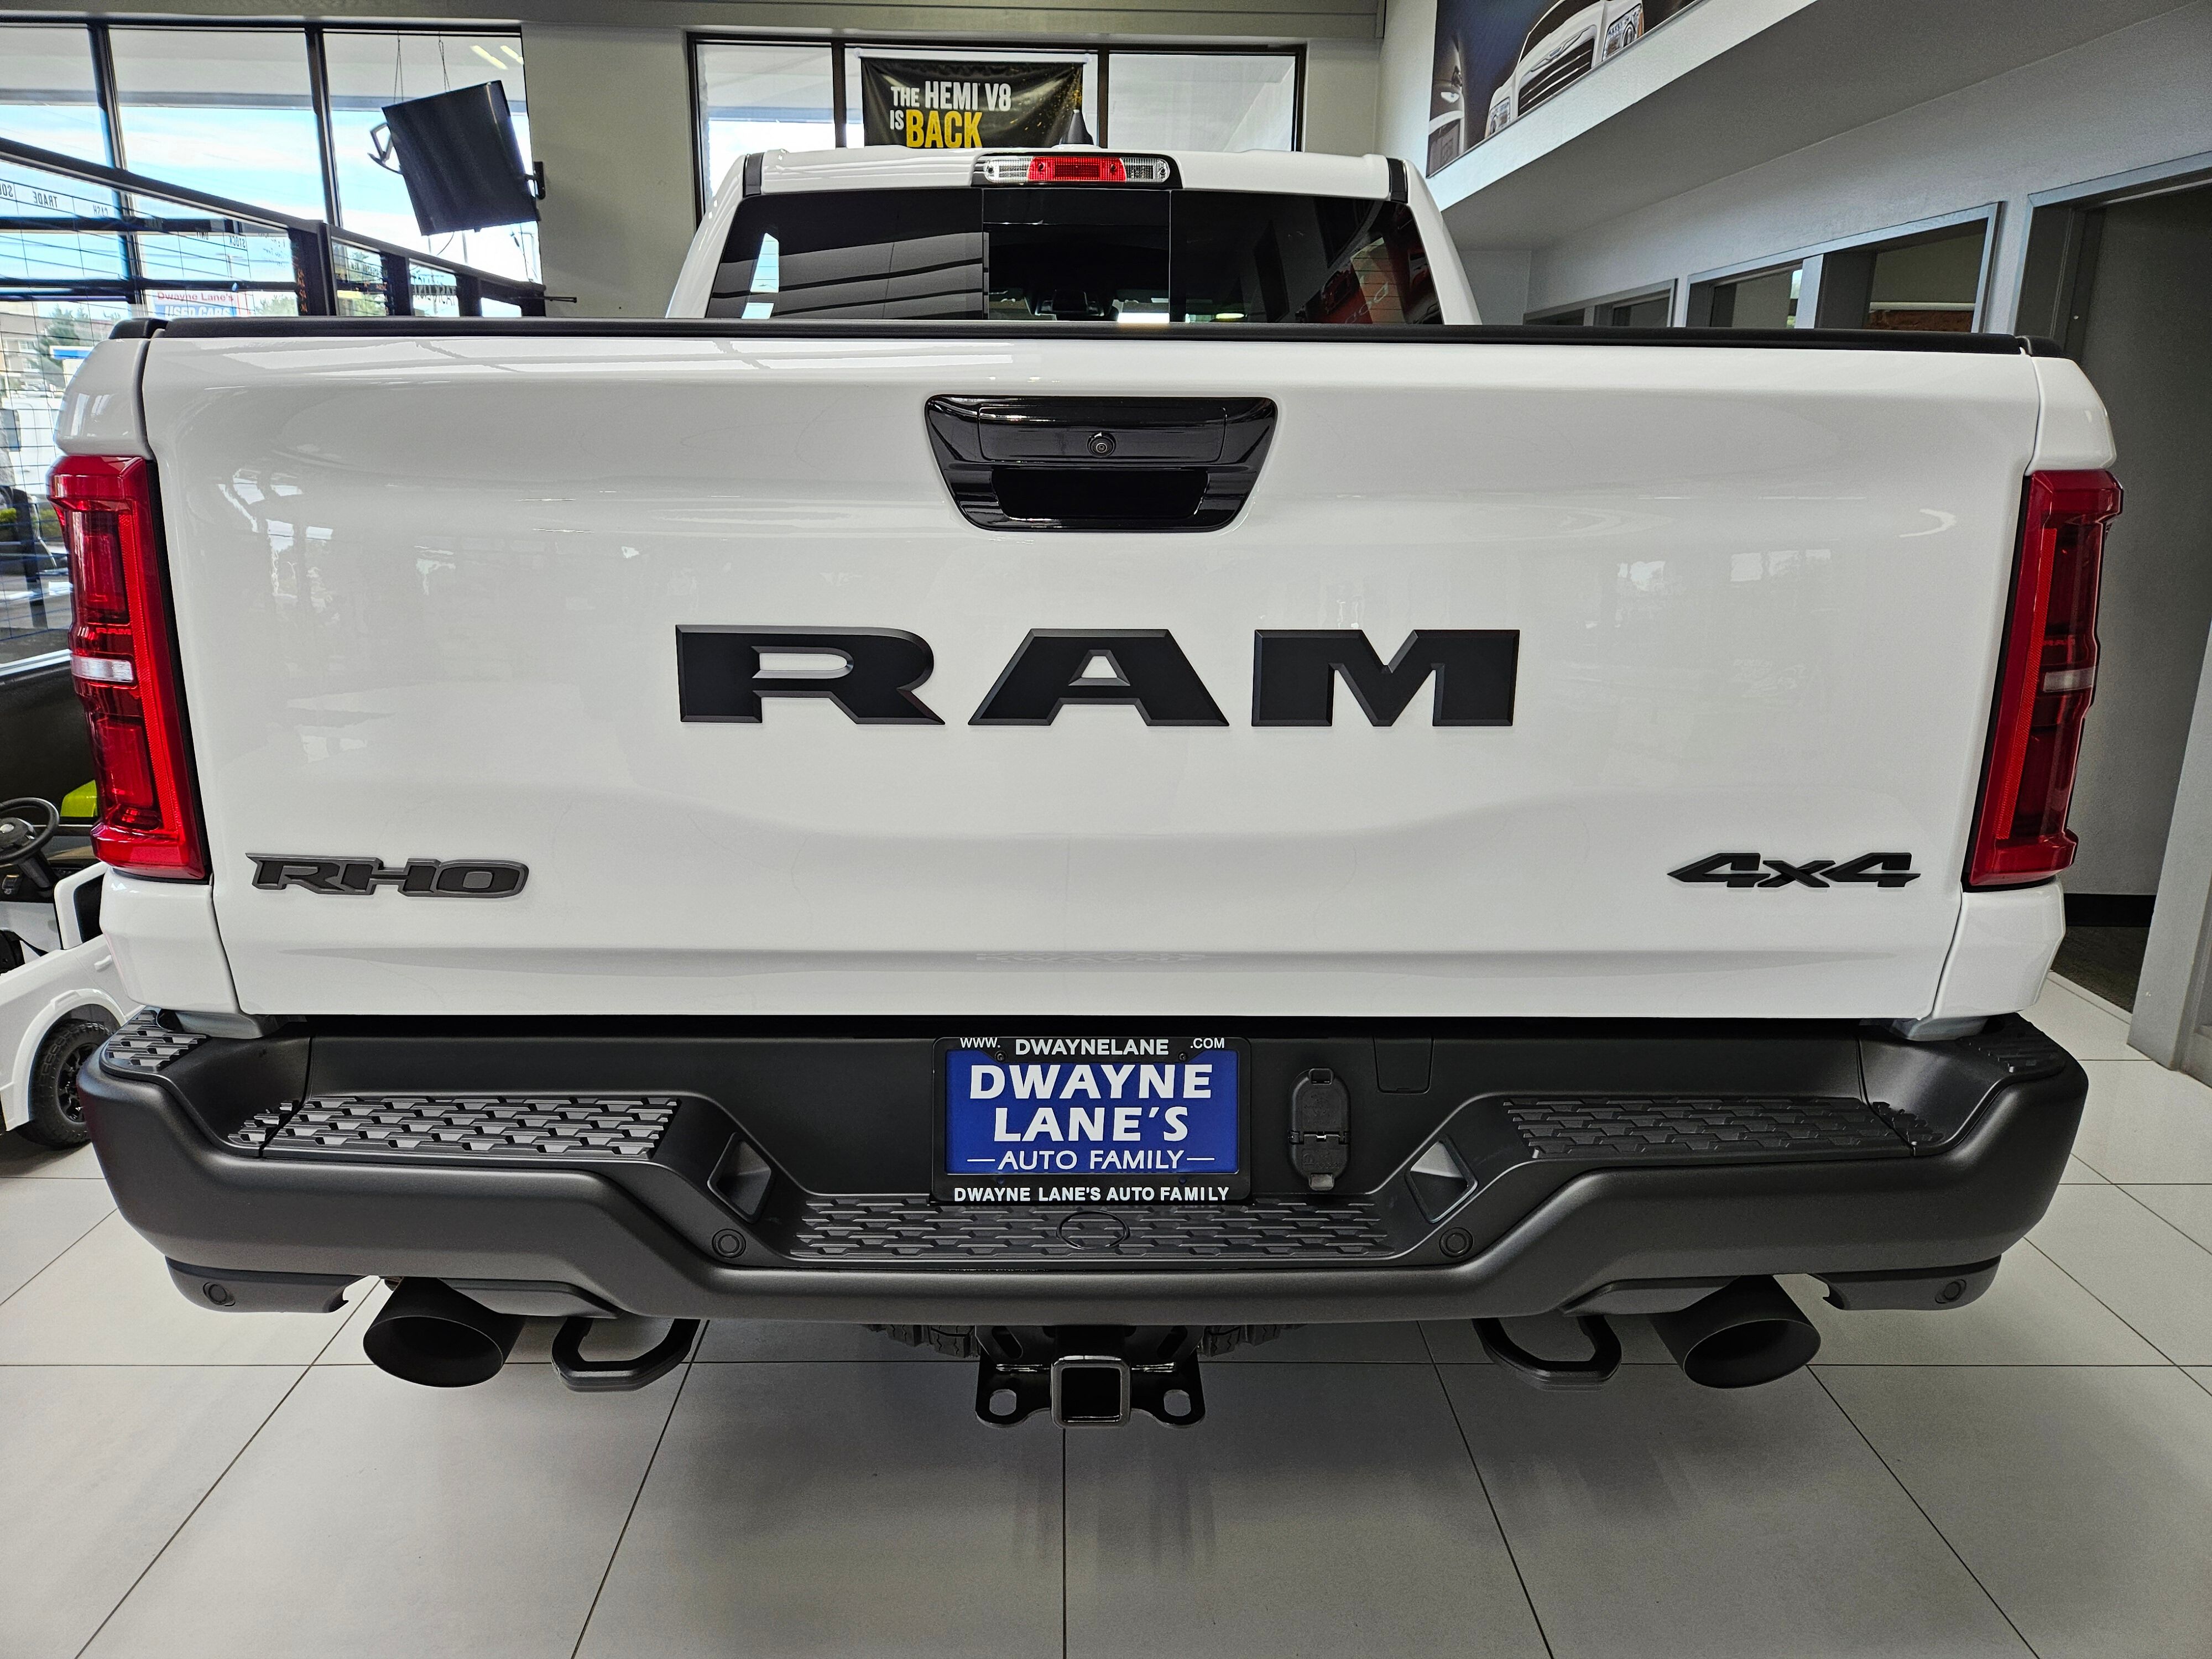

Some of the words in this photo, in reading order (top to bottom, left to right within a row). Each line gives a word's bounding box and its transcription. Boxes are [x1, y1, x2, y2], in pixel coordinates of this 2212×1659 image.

[890, 86, 920, 108] THE
[925, 81, 979, 110] HEMI
[985, 83, 1011, 112] V8
[890, 109, 904, 130] IS
[906, 109, 983, 148] BACK
[157, 291, 197, 301] Dwayne
[201, 293, 234, 302] Lane's
[675, 624, 1520, 727] RAM
[245, 852, 529, 898] RHO
[1667, 852, 1921, 888] 4x4
[960, 1037, 1000, 1048] WWW.
[1015, 1039, 1168, 1055] DWAYNELANE
[1190, 1037, 1225, 1049] .COM
[970, 1064, 1212, 1099] DWAYNE
[994, 1106, 1188, 1142] LANE'S
[998, 1150, 1077, 1170] AUTO
[1090, 1150, 1185, 1170] FAMILY
[954, 1187, 1030, 1202] DWAYNE
[1039, 1187, 1101, 1202] LANE'S
[1107, 1187, 1155, 1201] AUTO
[1160, 1186, 1230, 1201] FAMILY
